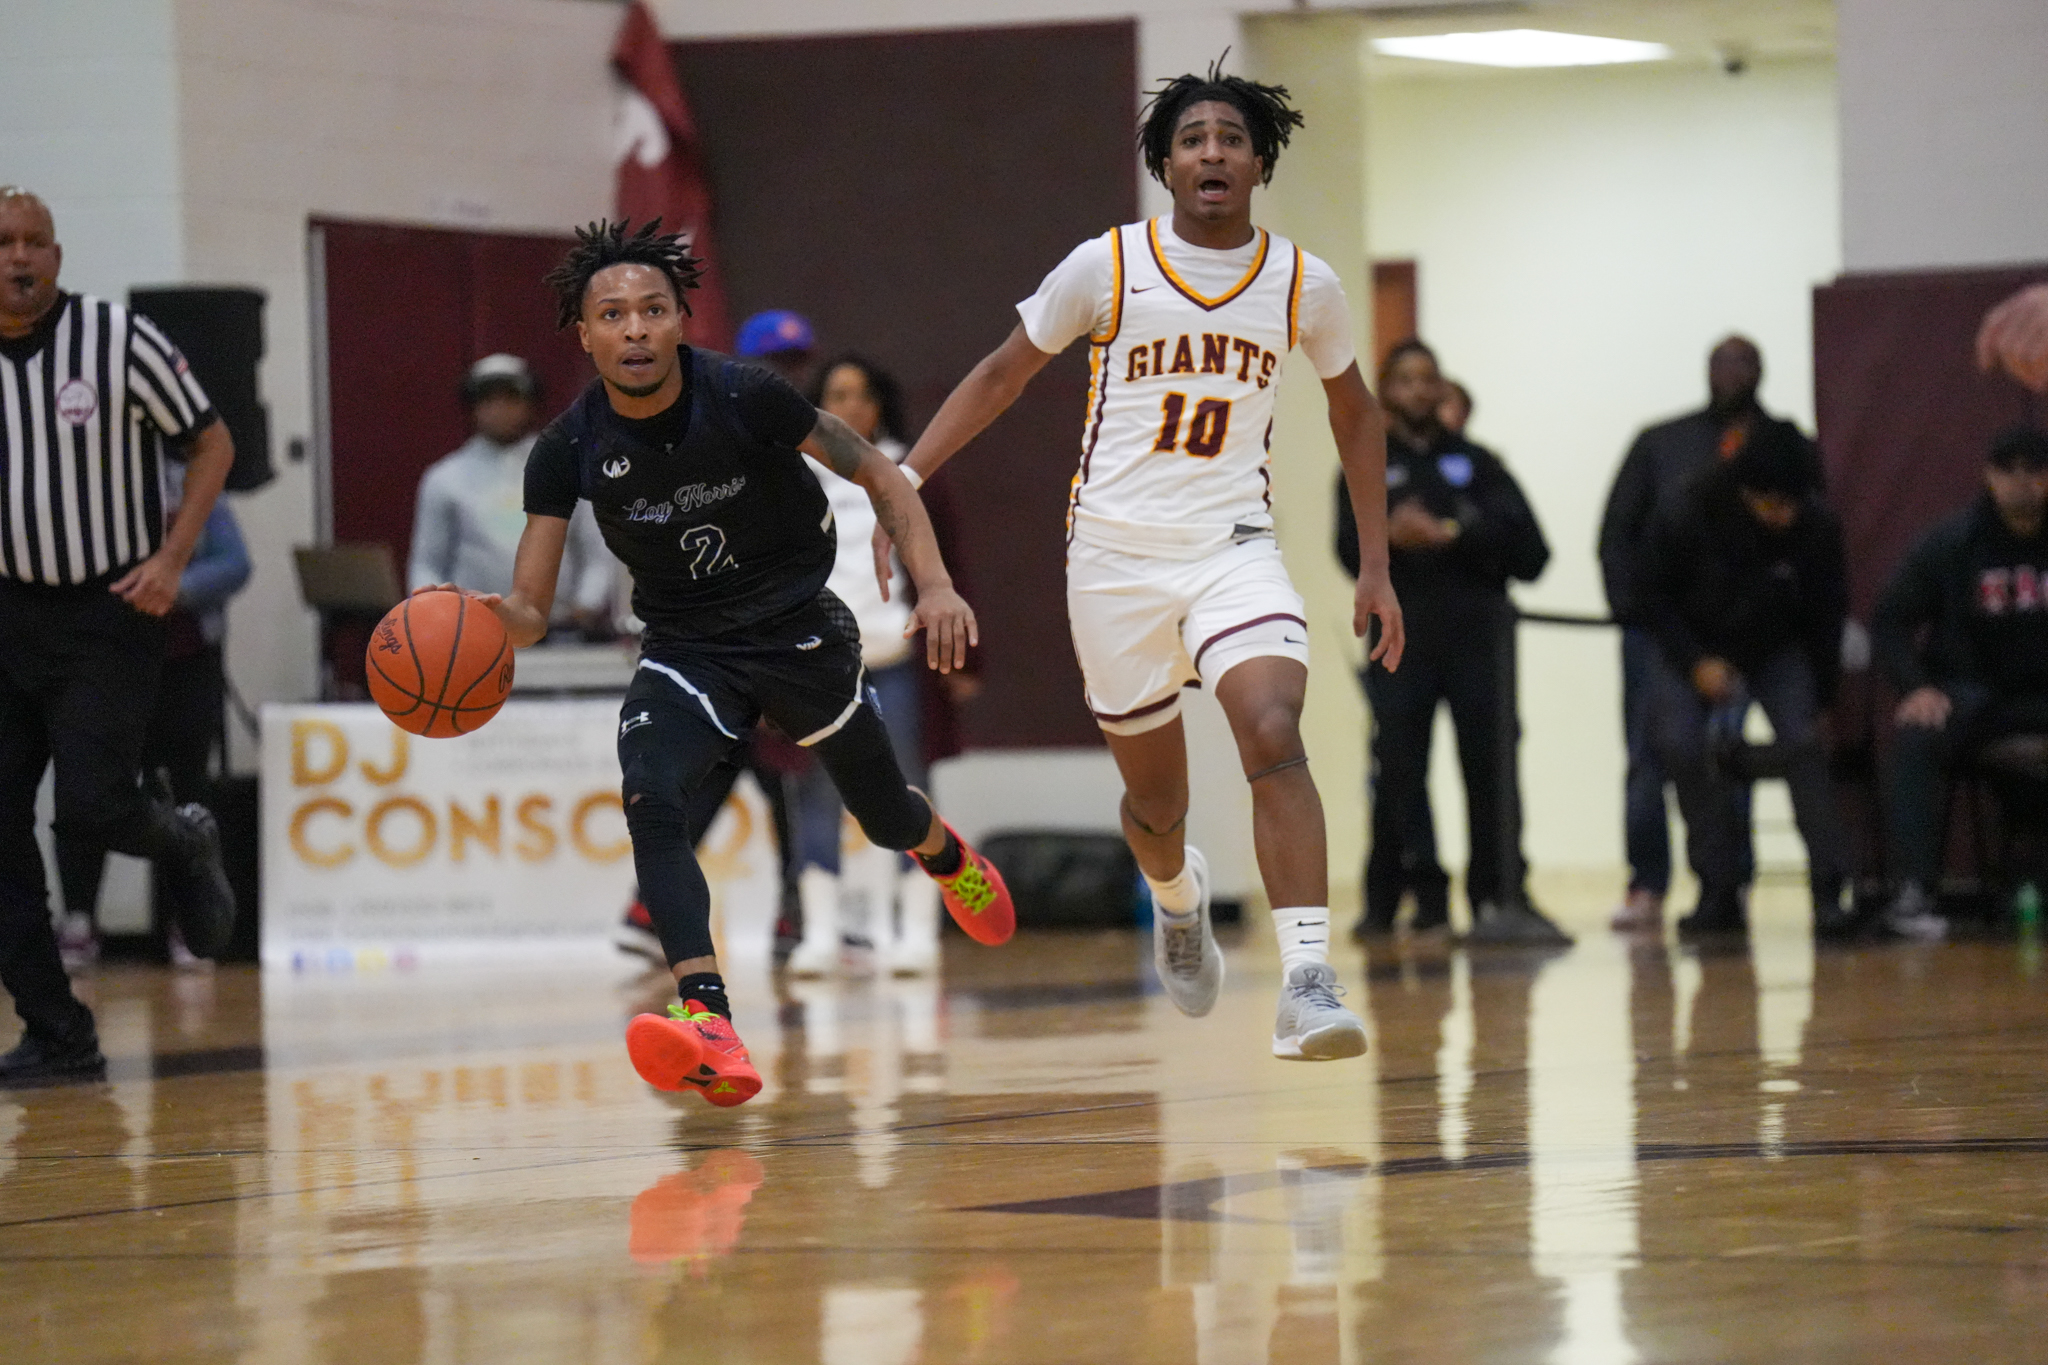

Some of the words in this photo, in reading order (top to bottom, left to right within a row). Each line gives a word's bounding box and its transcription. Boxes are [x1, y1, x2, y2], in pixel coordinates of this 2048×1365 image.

[1124, 332, 1277, 390] GIANTS
[1152, 391, 1233, 460] 10
[621, 498, 674, 525] Loy
[680, 524, 739, 581] 2
[289, 719, 410, 787] DJ
